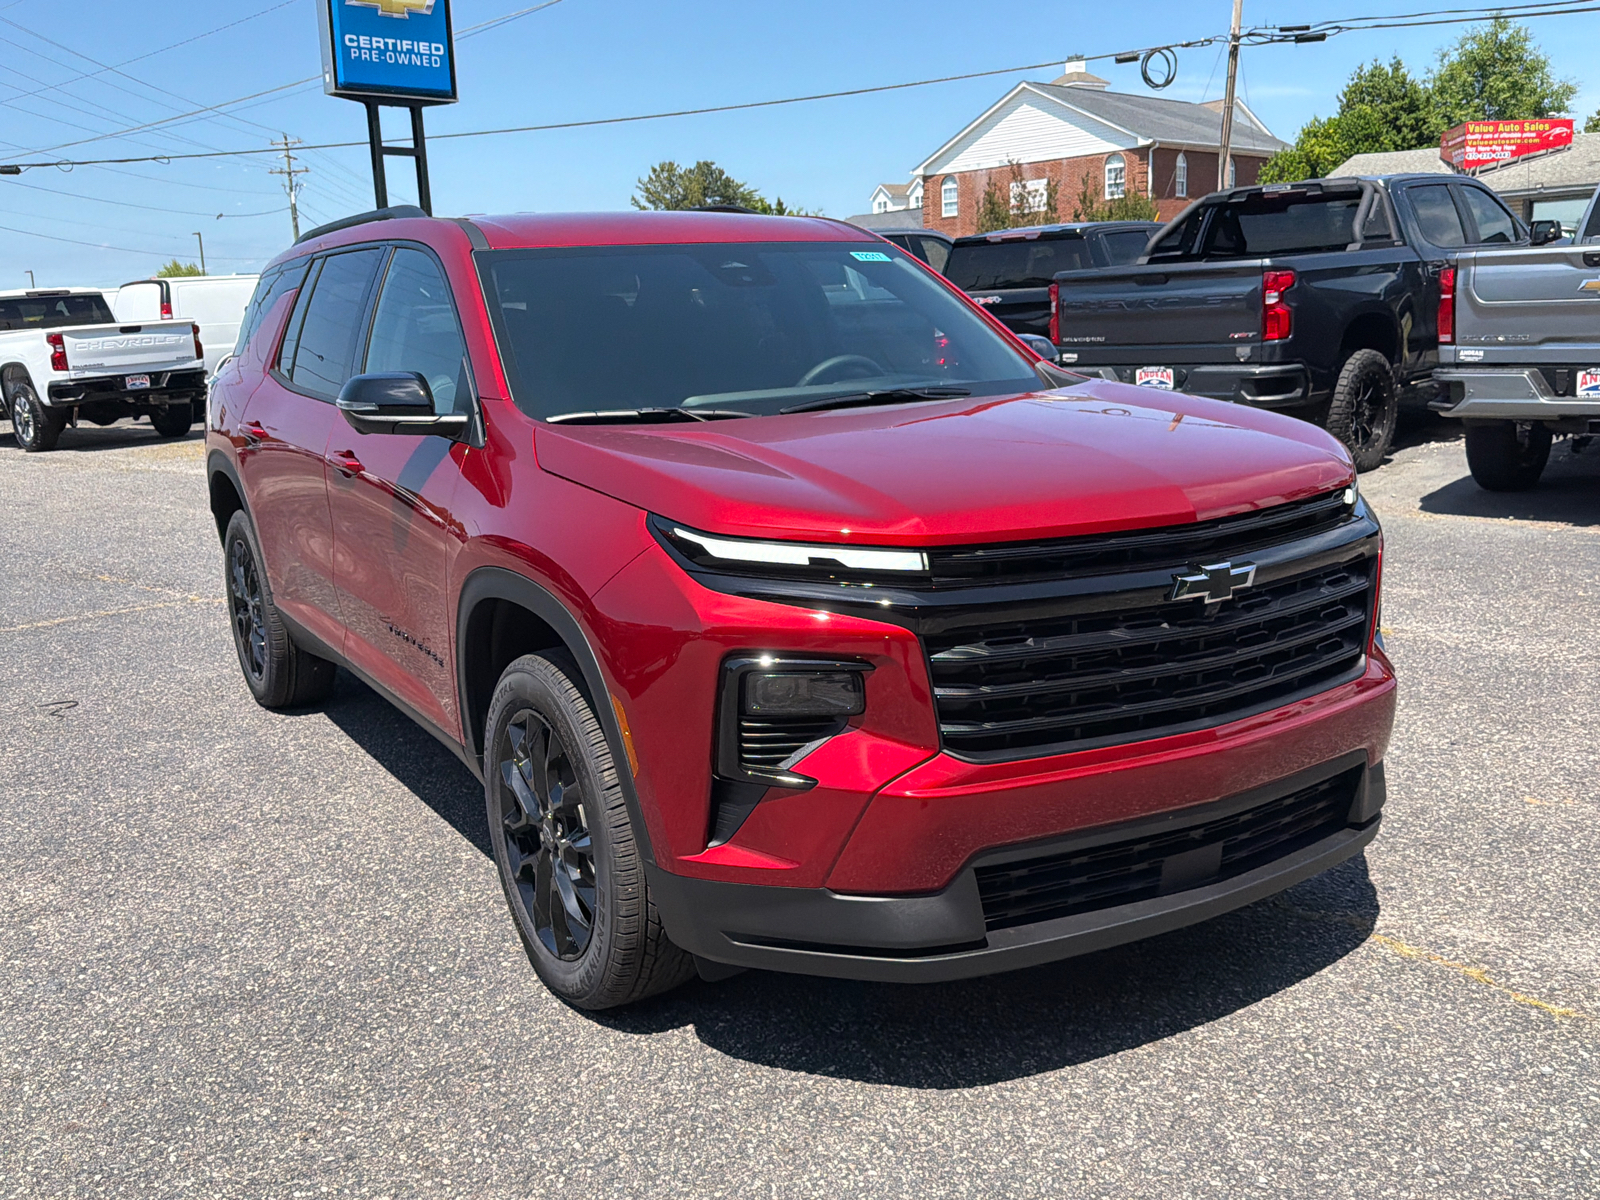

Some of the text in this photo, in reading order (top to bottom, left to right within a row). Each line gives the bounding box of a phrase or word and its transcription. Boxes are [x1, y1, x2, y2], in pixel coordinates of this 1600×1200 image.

[344, 34, 444, 55] CERTIFIED
[351, 48, 441, 68] PRE-OWNED
[1468, 121, 1550, 134] Value Auto Sales
[75, 335, 187, 351] CHEVROLET
[1138, 371, 1172, 383] ANDEAN
